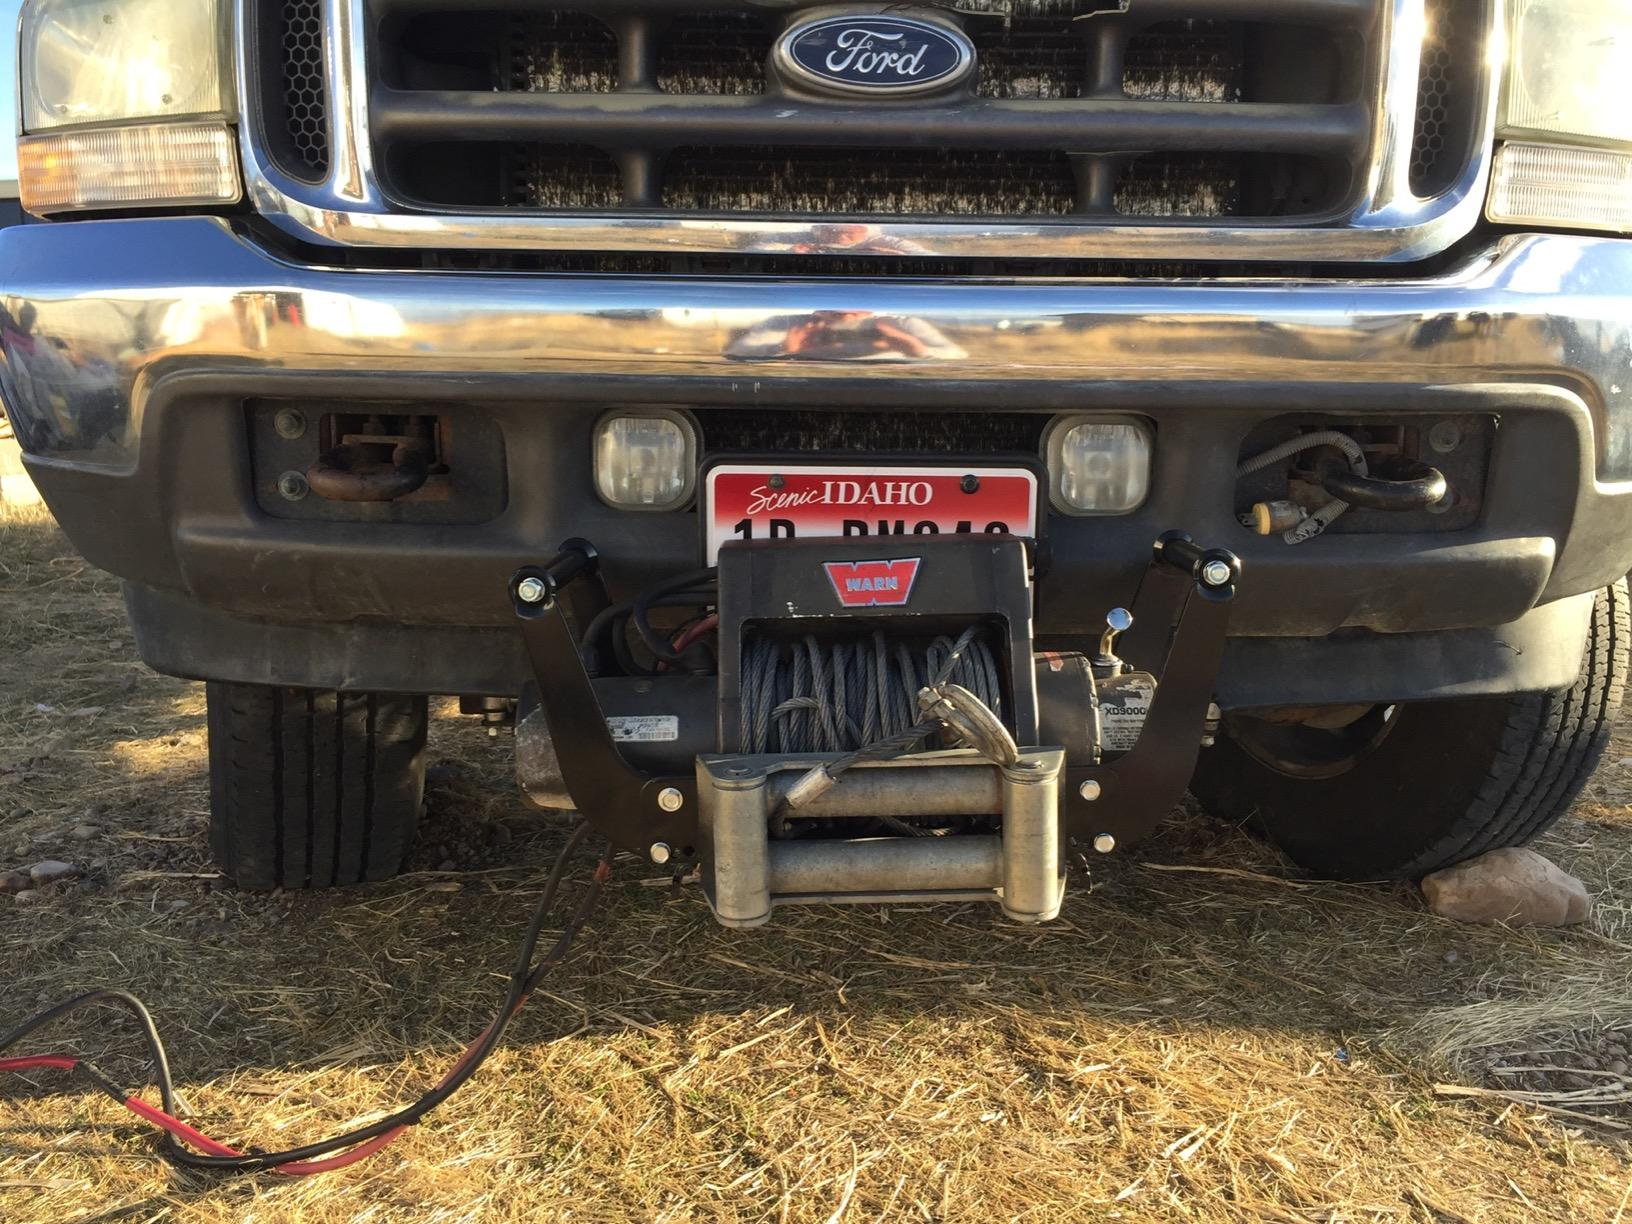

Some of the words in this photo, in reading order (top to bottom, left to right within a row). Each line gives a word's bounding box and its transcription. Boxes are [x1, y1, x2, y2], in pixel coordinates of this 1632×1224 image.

[825, 29, 929, 75] Ford
[746, 485, 824, 515] Scenic
[821, 480, 933, 506] IDAHO
[846, 576, 898, 592] WARN
